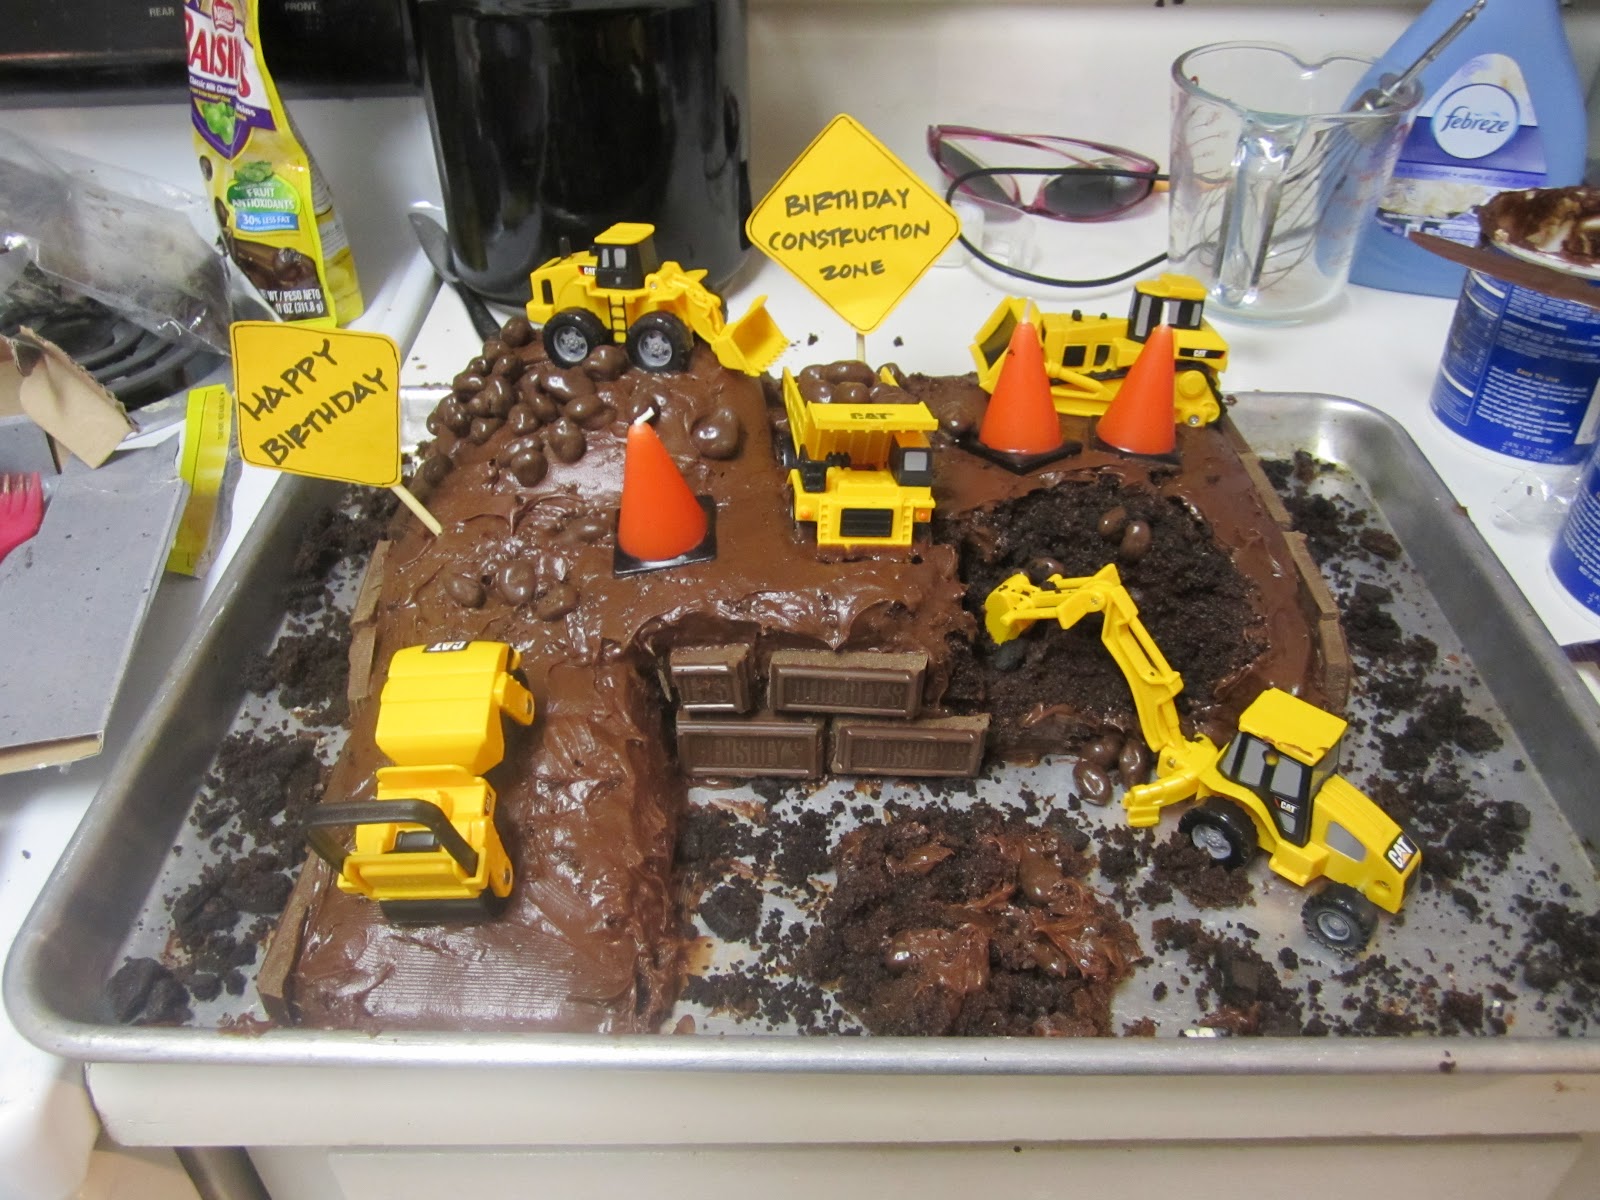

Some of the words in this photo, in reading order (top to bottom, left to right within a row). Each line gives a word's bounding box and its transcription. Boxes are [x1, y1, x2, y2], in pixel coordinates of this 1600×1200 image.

[149, 6, 175, 17] REAR
[284, 1, 317, 11] FRONT
[1440, 105, 1510, 133] febreze
[246, 187, 275, 197] FRUIT
[232, 198, 295, 209] ANTIOXIDANTS
[784, 187, 910, 218] BIRTHDAY
[242, 214, 261, 225] 30%
[262, 216, 277, 224] LESS
[277, 215, 291, 224] FAT
[768, 220, 931, 251] CONSTRUCTION
[583, 266, 596, 276] CAT
[818, 259, 886, 281] ZONE
[267, 290, 278, 301] WT
[283, 290, 302, 301] PESO
[302, 288, 321, 300] NETO
[283, 302, 293, 314] OZ
[1193, 349, 1208, 357] CAT
[239, 338, 338, 421] HAPPY
[259, 367, 389, 466] BIRTHDAY
[850, 412, 894, 420] CAT
[427, 640, 467, 651] CAT
[1280, 800, 1297, 813] CAT
[1387, 835, 1414, 869] CAT
